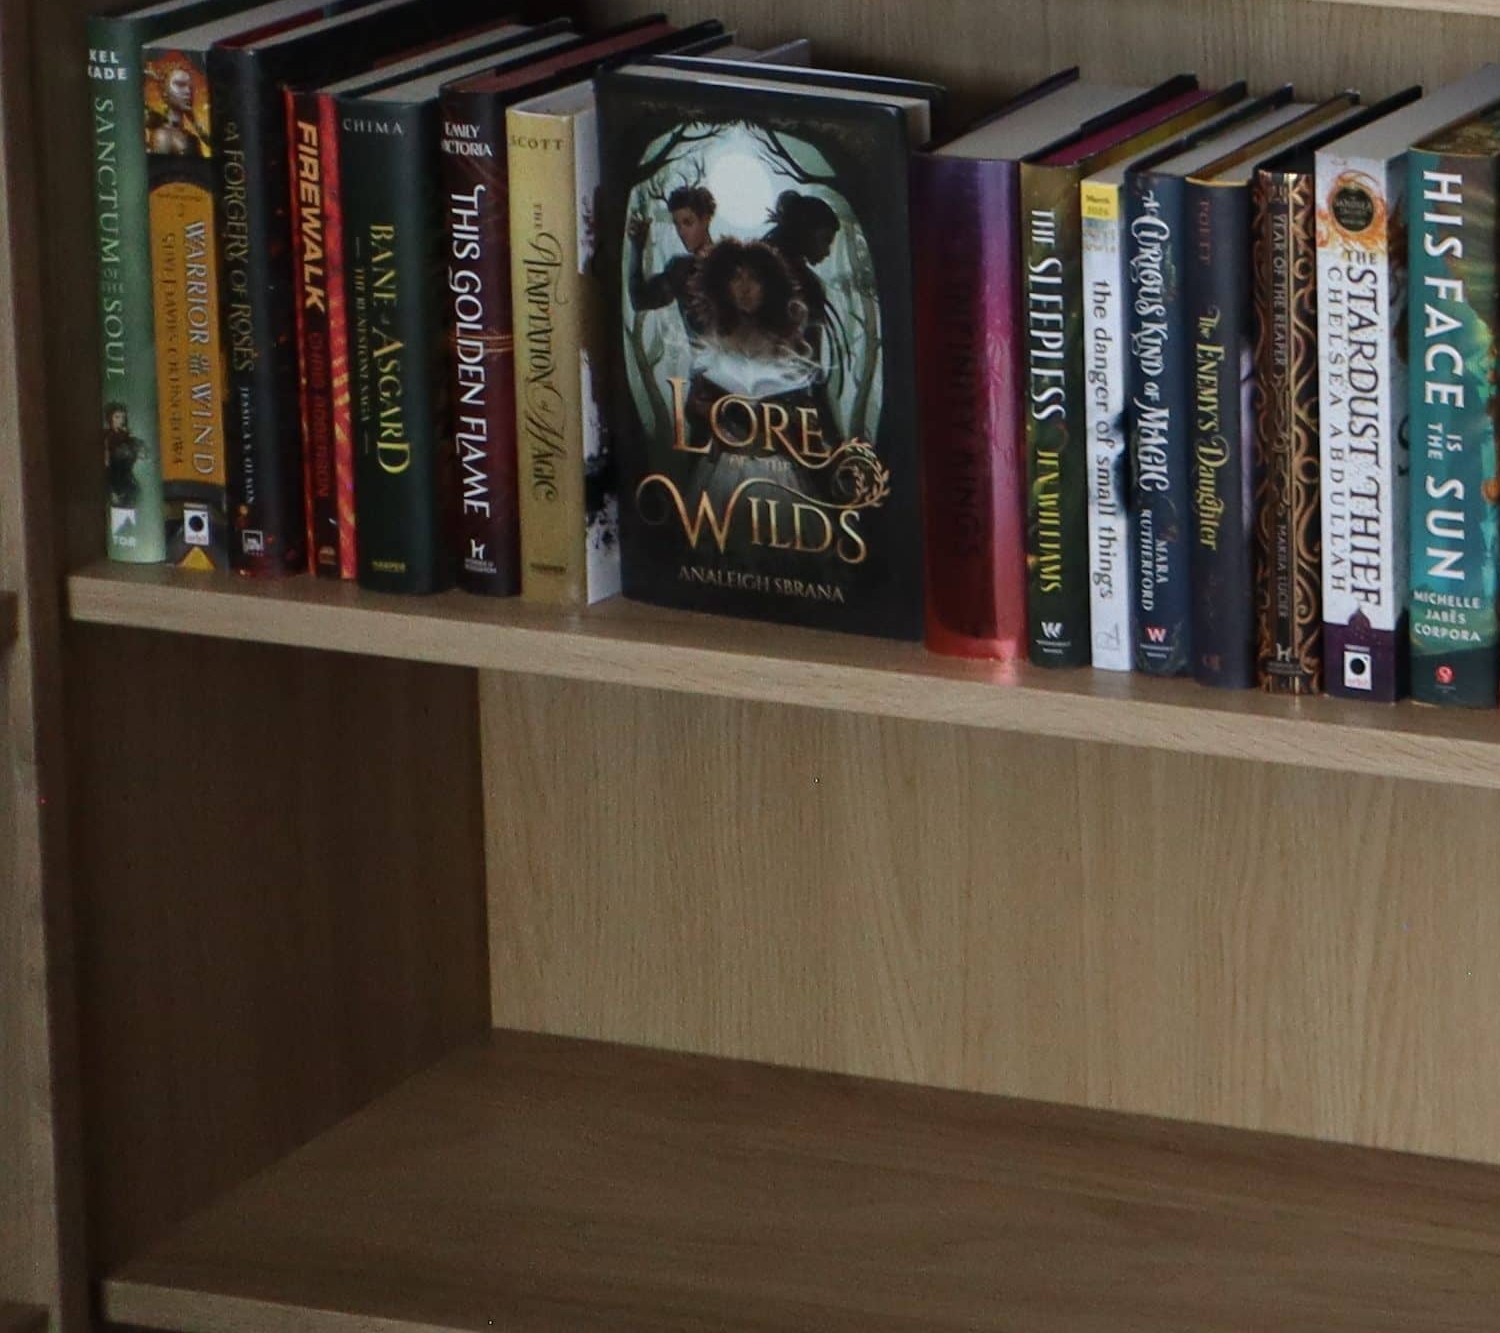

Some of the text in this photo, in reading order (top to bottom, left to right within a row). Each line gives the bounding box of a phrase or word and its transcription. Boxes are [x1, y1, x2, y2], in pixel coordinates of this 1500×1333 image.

[296, 120, 326, 314] FIREWALK
[1422, 168, 1465, 411] HIS FACE
[678, 565, 846, 604] ANALEIGH SBRANA
[1426, 473, 1466, 582] SUN
